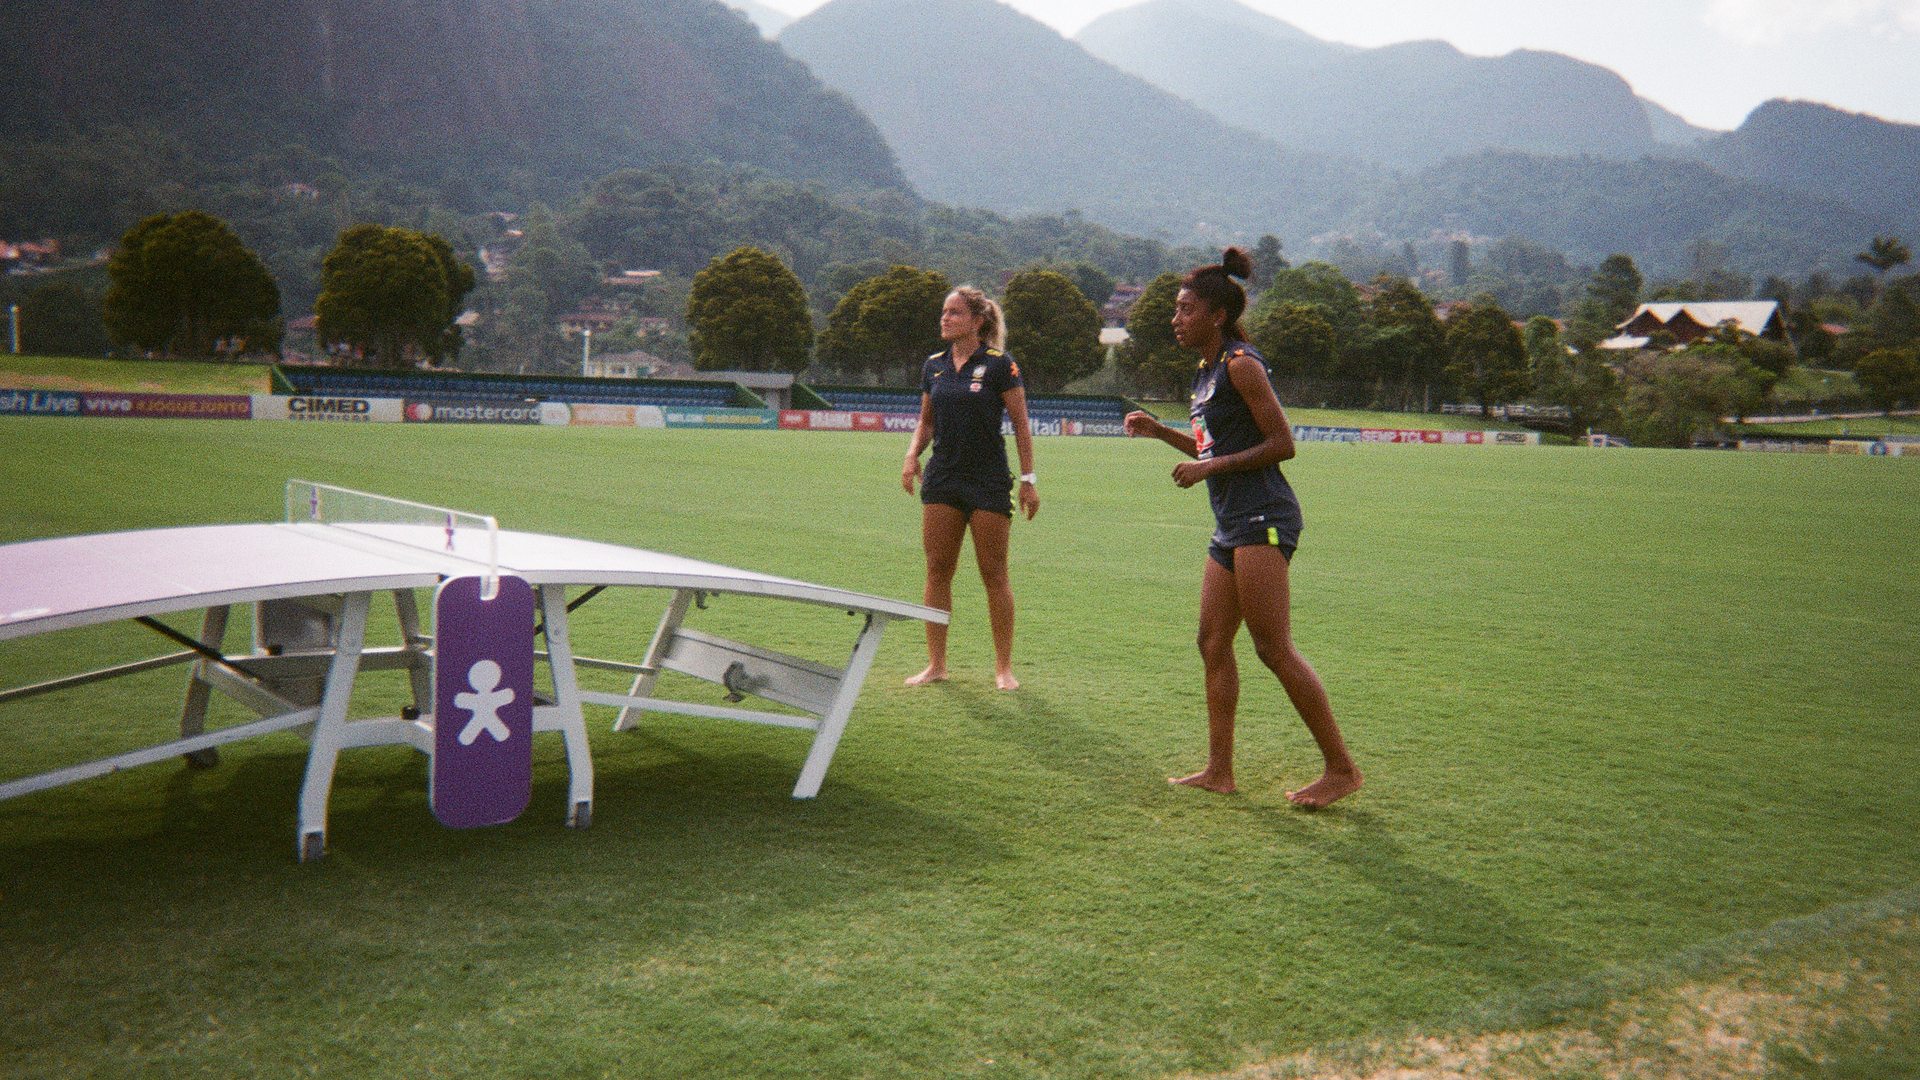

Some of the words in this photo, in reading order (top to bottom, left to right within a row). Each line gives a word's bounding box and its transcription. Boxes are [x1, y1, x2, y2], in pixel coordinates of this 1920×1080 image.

[31, 393, 79, 412] Live
[85, 399, 132, 412] vivo
[288, 398, 371, 413] CIMED
[435, 404, 540, 420] mastercard
[883, 417, 919, 430] vivo
